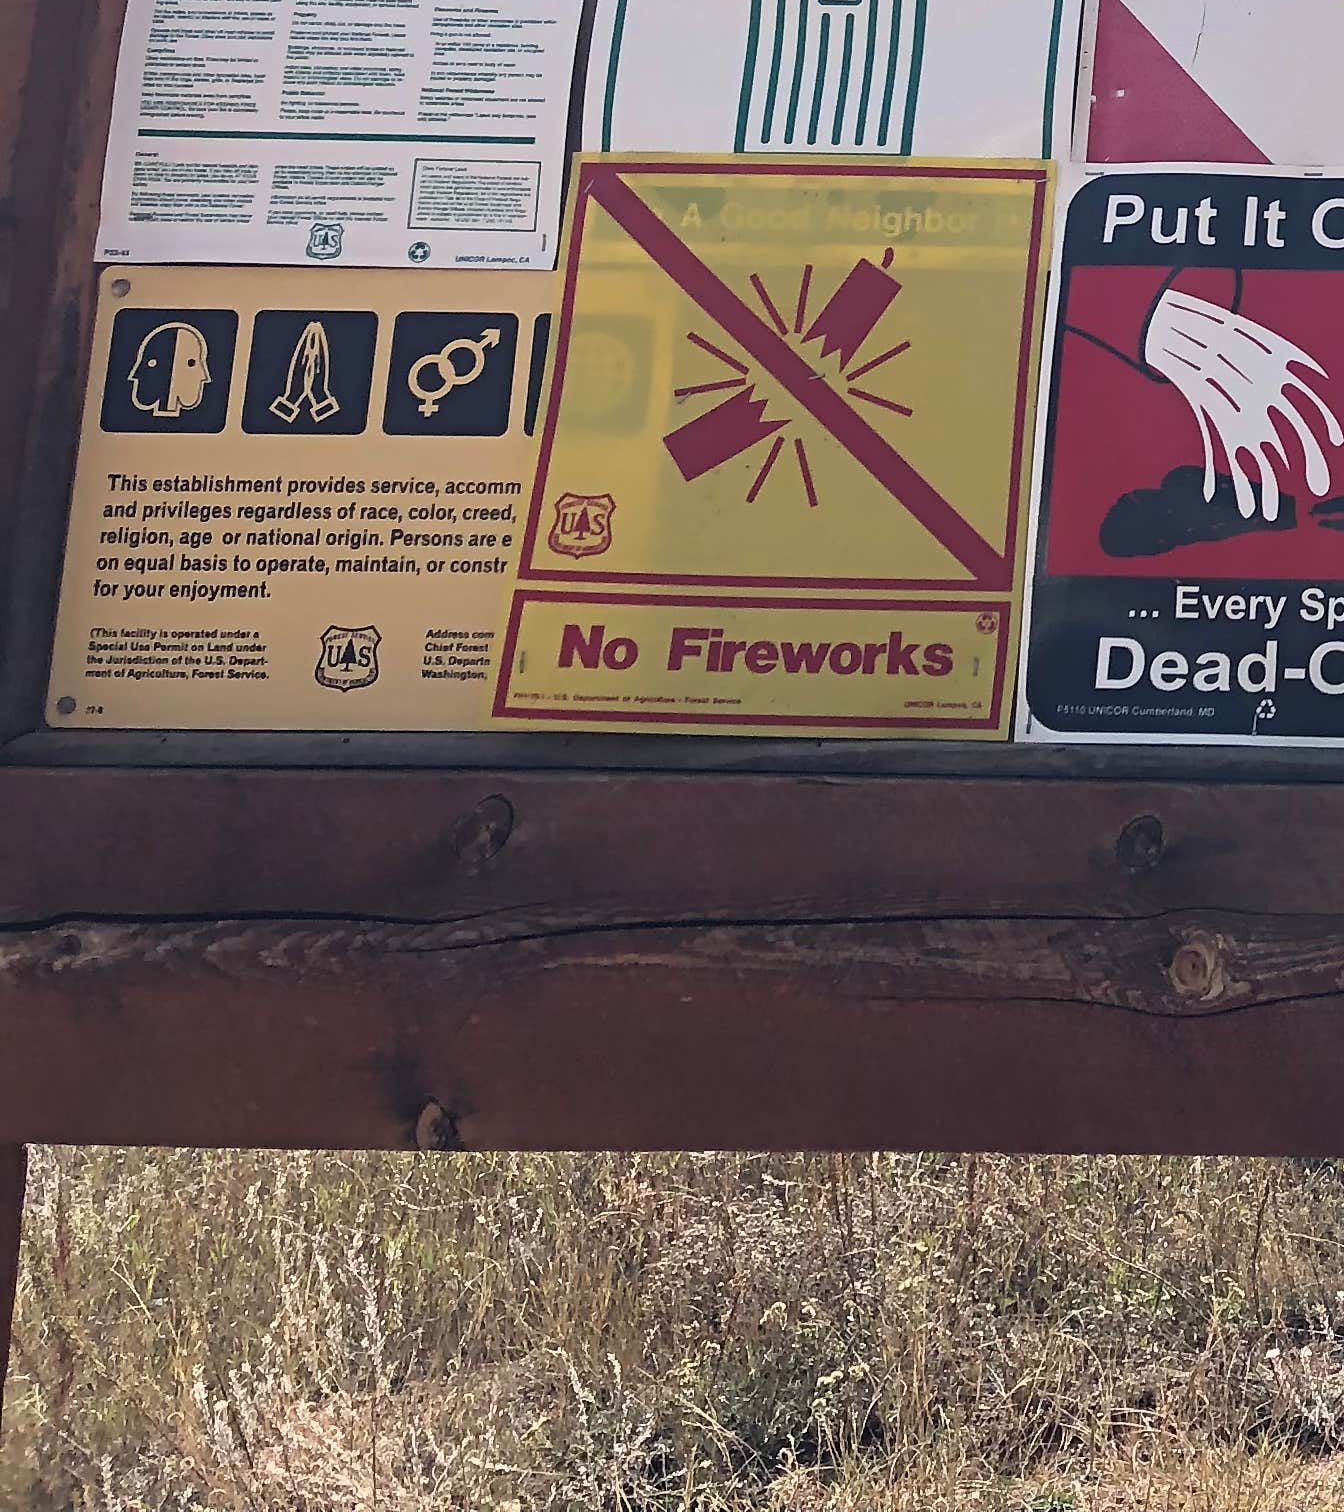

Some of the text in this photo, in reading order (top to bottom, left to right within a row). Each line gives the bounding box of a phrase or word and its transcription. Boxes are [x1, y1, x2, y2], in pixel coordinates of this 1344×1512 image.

[1103, 194, 1217, 245] Put
[1244, 196, 1285, 247] It
[103, 500, 516, 524] and privileges regardless of race, color, creed,
[93, 579, 270, 601] for your enjoyment.
[1175, 586, 1286, 626] Every
[558, 624, 953, 676] No Fireworks
